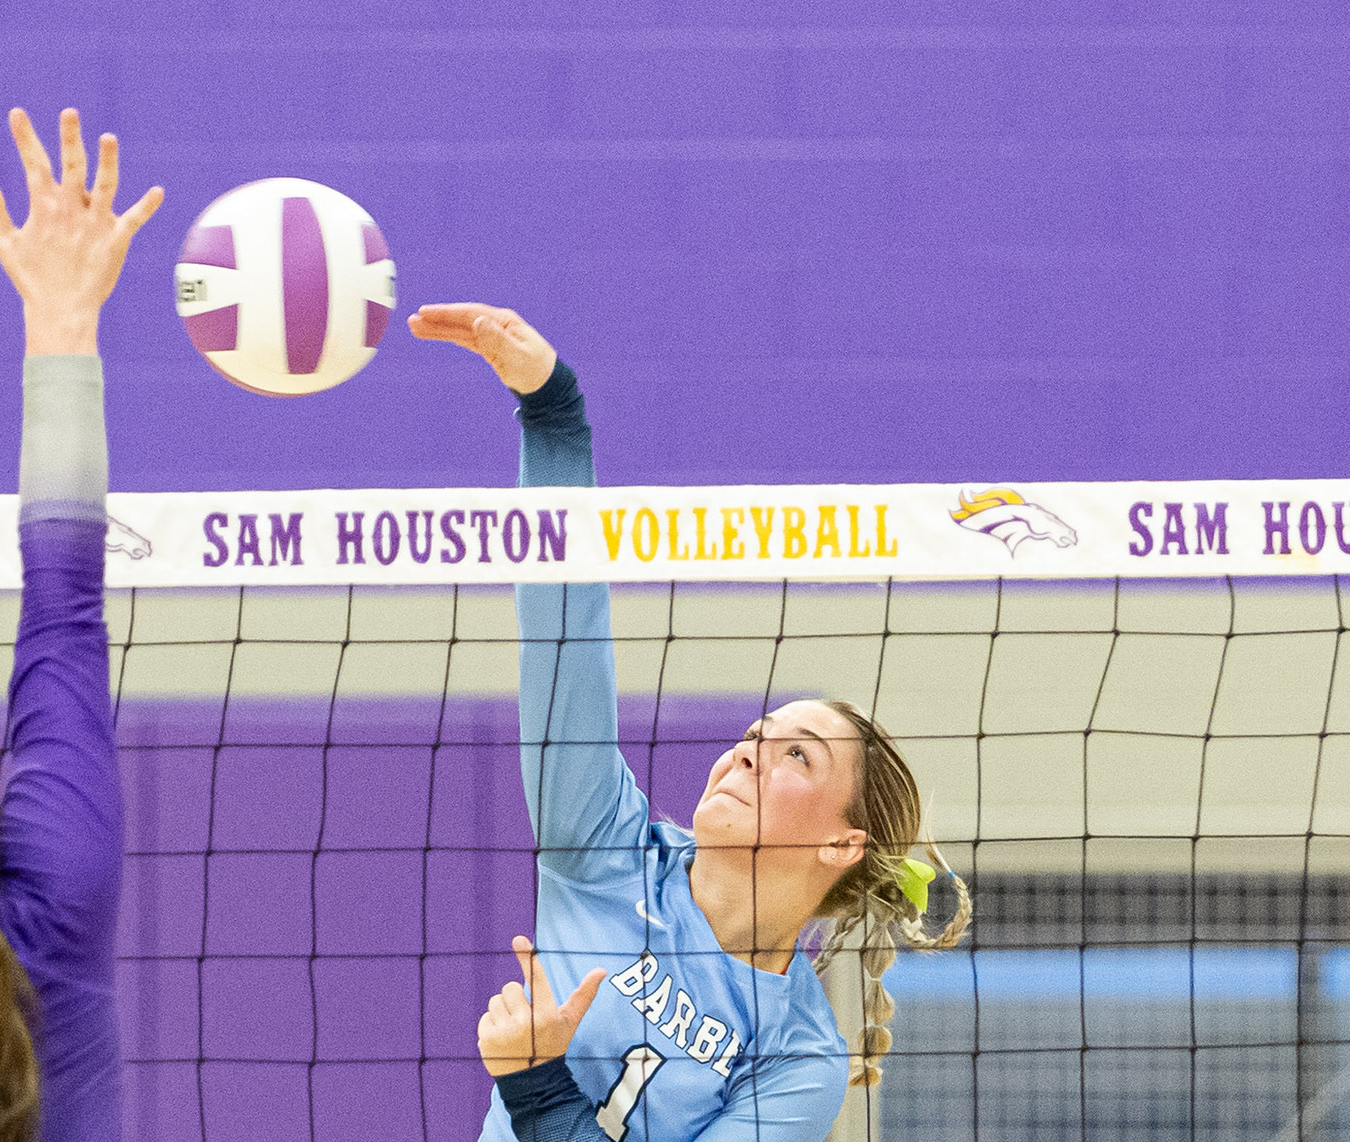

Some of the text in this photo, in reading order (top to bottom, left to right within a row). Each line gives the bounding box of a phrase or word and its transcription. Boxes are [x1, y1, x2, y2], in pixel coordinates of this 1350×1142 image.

[202, 505, 898, 567] SAM HOUSTON VOLLEYBALL
[1128, 501, 1230, 556] SAM
